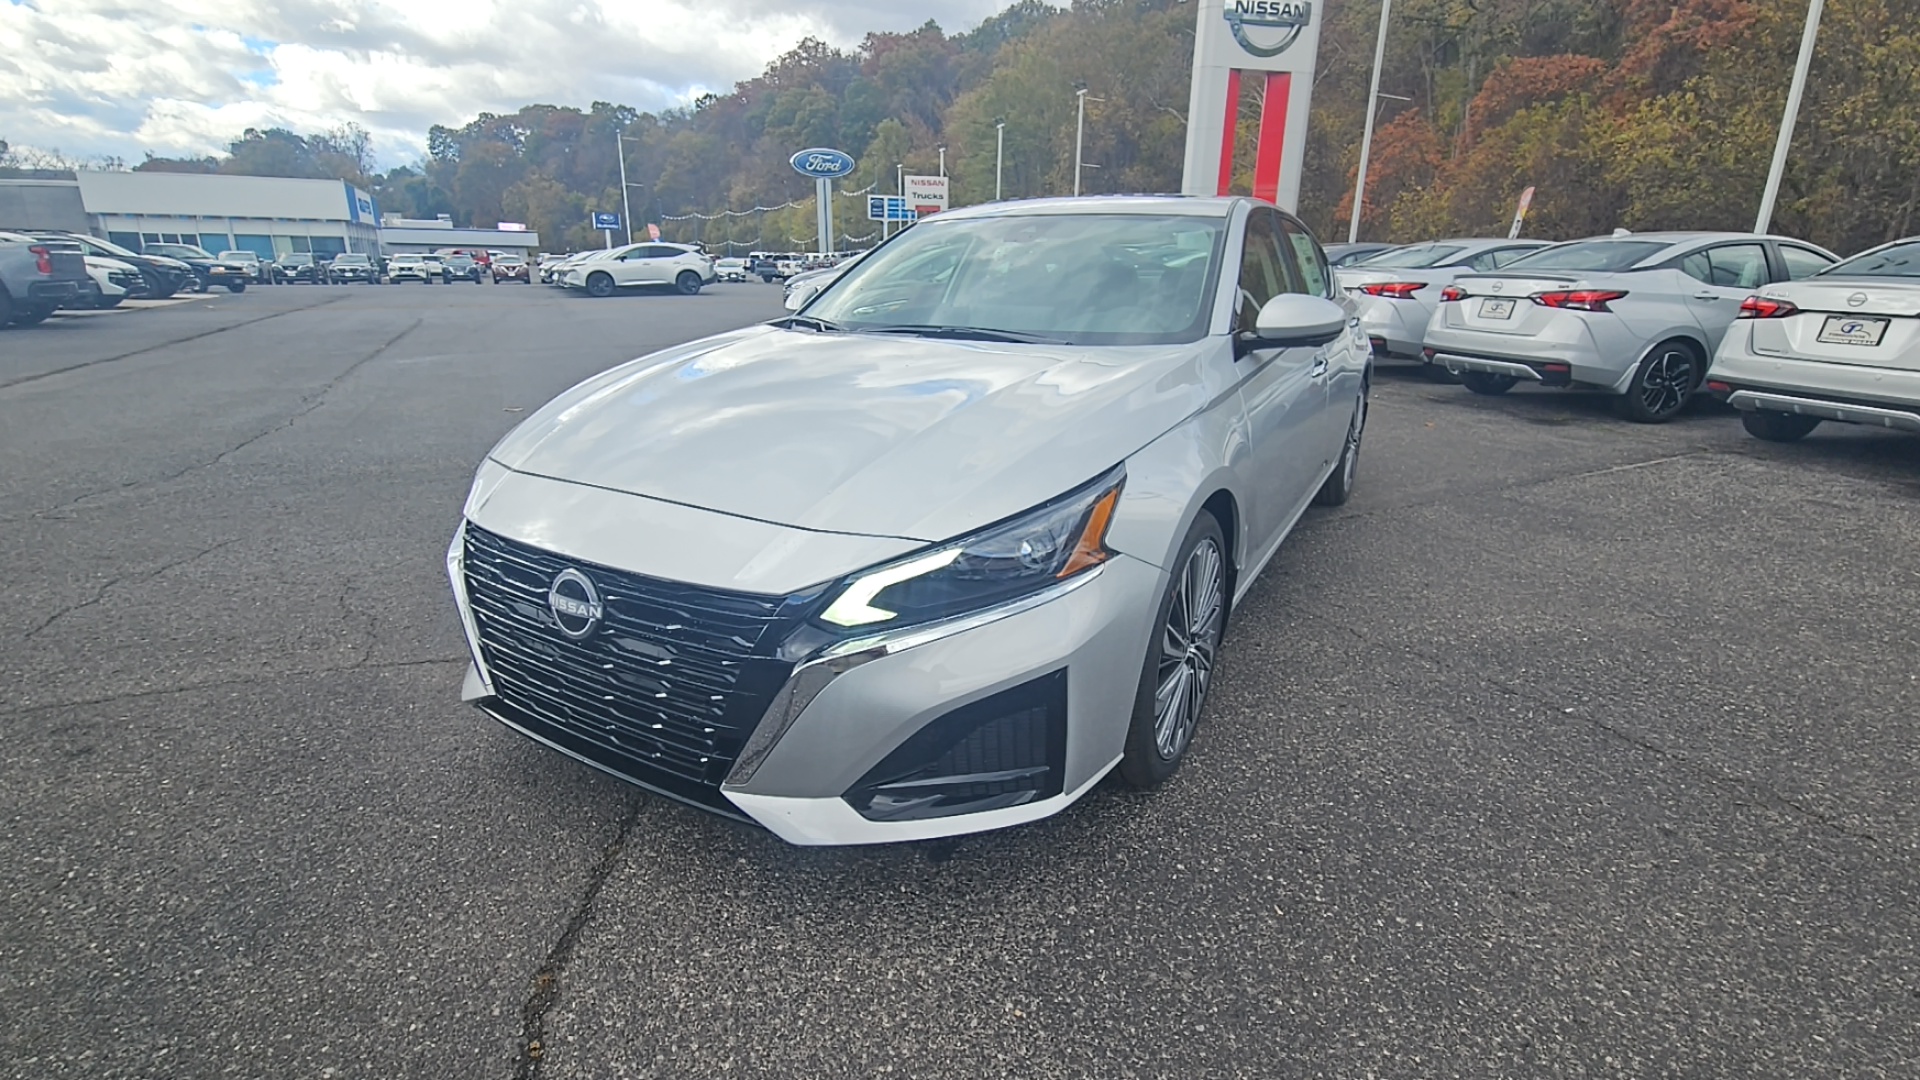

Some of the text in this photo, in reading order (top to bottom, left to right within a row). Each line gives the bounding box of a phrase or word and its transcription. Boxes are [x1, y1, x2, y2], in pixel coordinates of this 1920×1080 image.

[1235, 0, 1305, 18] NISSAN
[806, 154, 842, 171] Ford
[911, 179, 945, 187] NISSAN
[912, 192, 944, 200] Trucks
[551, 593, 602, 618] NISSAN
